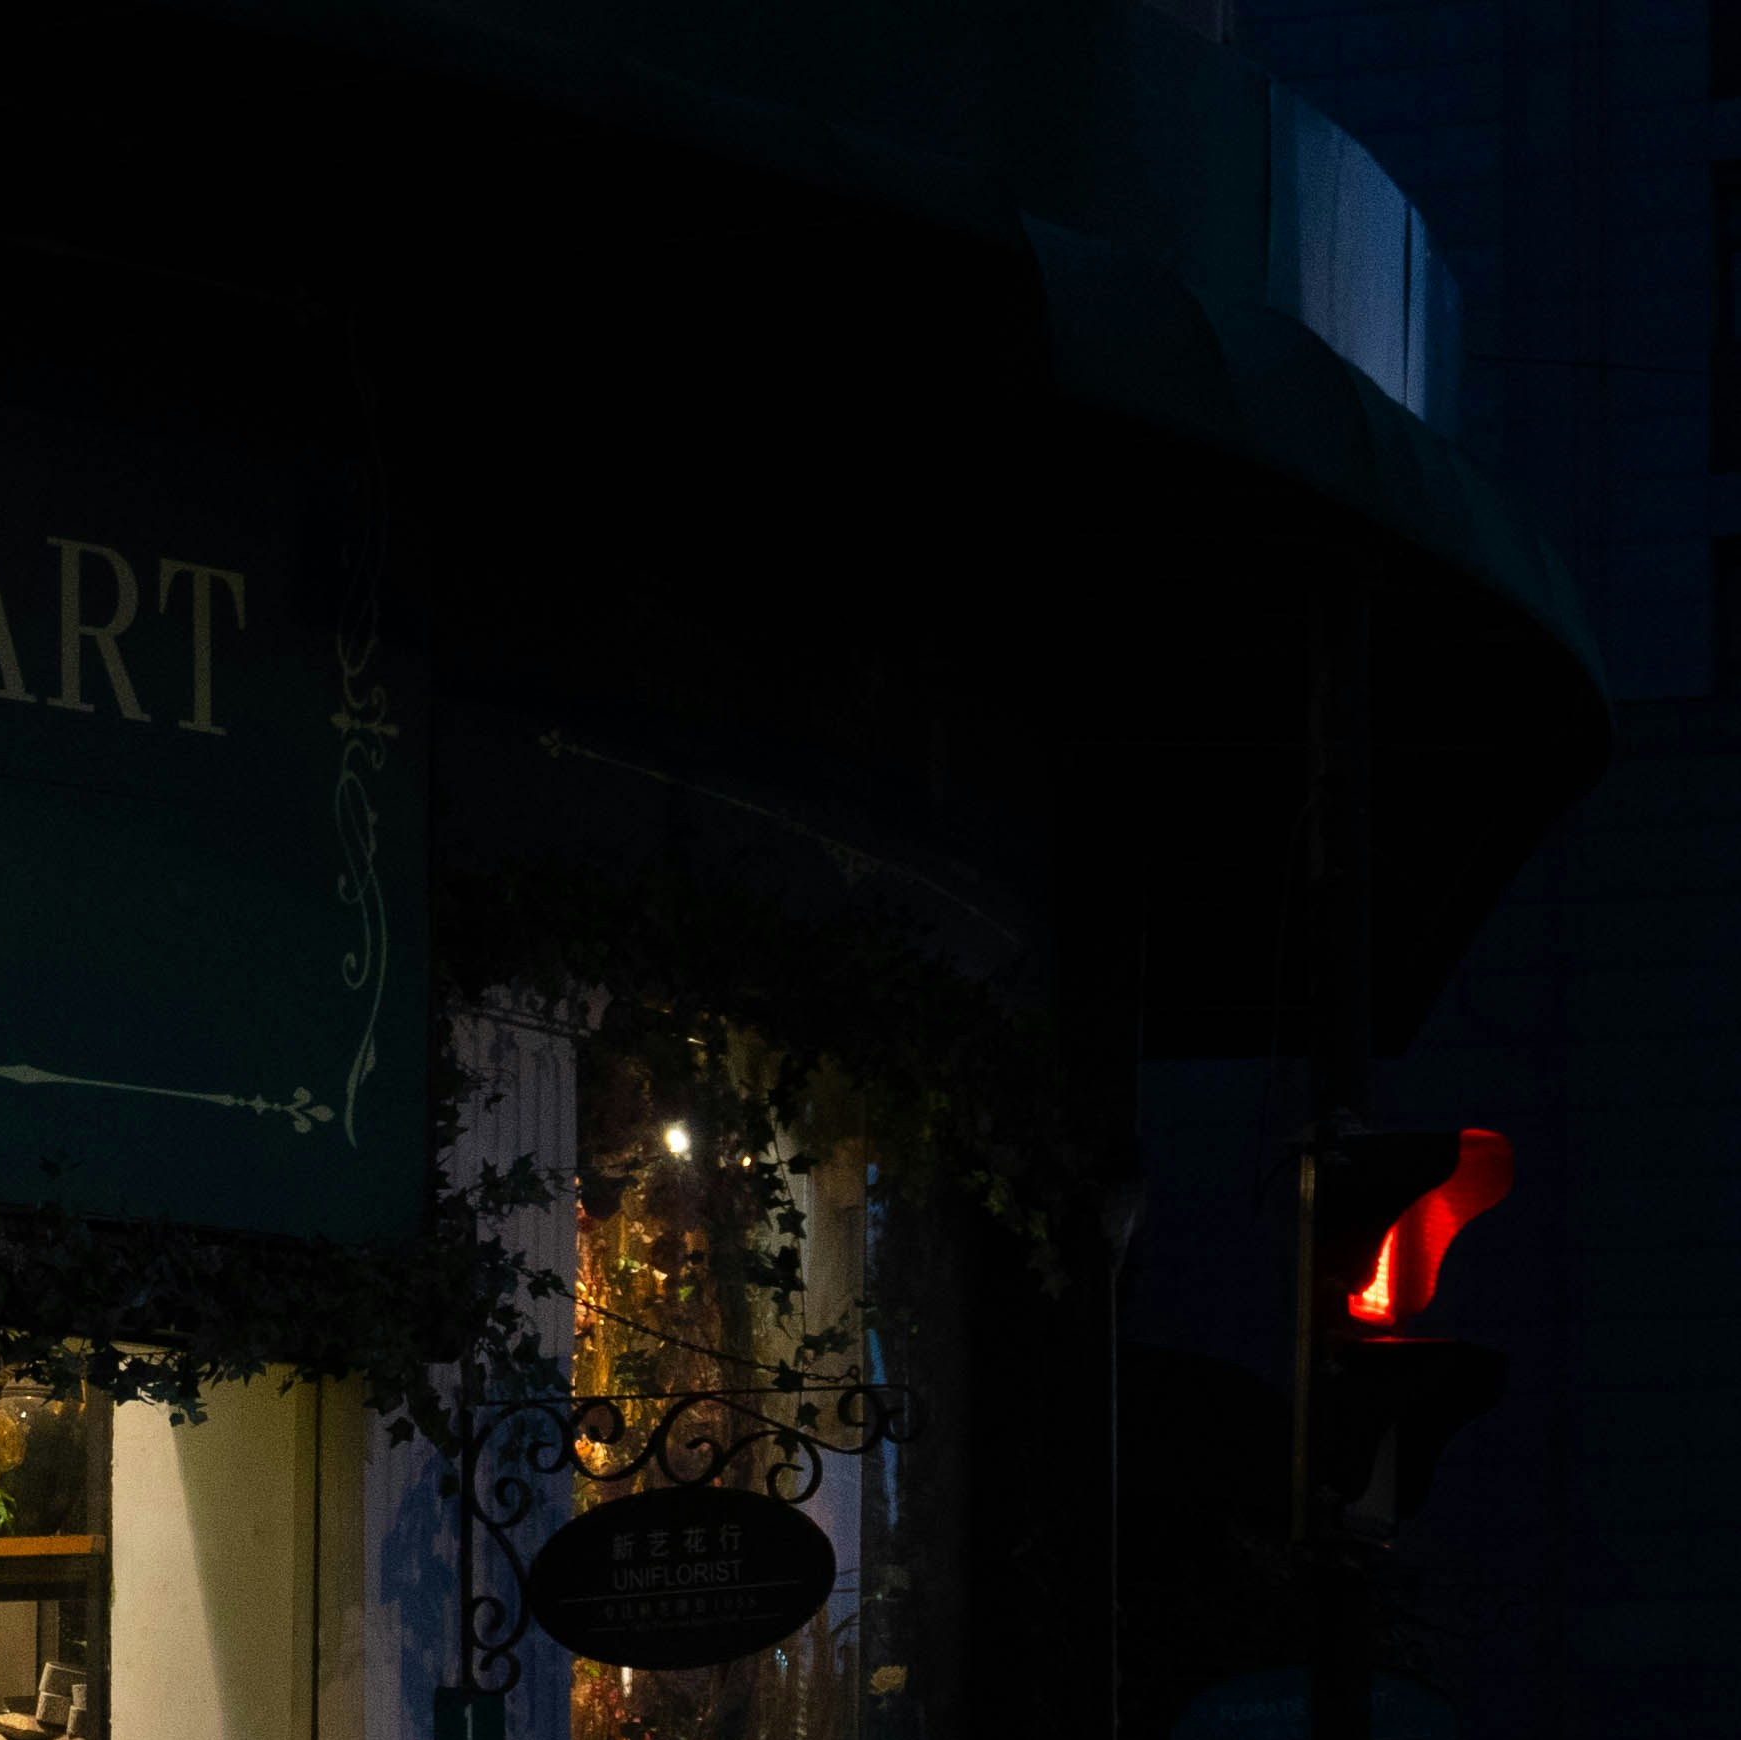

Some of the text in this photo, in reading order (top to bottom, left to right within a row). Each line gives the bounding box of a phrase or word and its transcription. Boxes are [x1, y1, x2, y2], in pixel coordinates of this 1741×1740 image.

[611, 1522, 743, 1561] 新艺花行
[612, 1560, 744, 1592] UNIFLORIST
